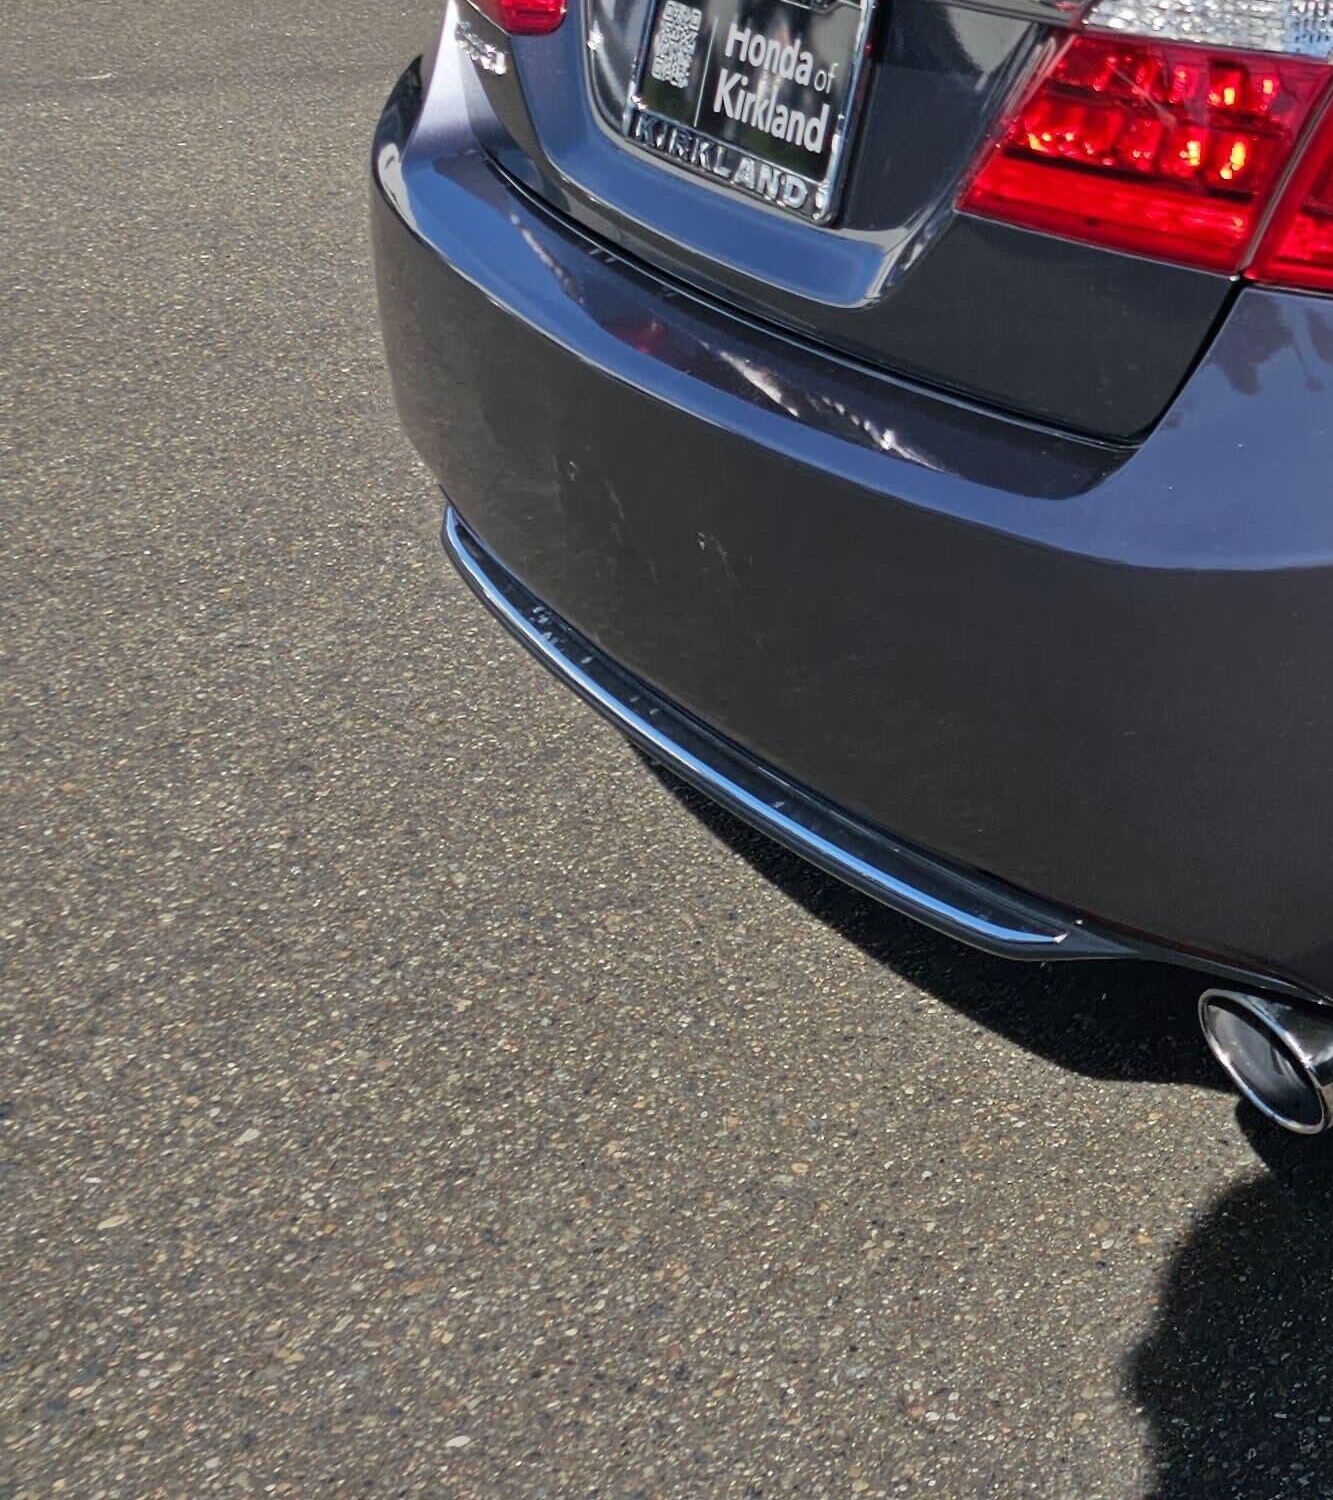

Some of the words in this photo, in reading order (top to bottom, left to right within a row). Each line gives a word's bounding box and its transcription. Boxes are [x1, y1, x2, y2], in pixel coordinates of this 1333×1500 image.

[724, 21, 813, 87] Honda
[814, 62, 840, 94] of
[712, 67, 830, 155] Kirkland
[633, 112, 809, 209] KIRKLAND
